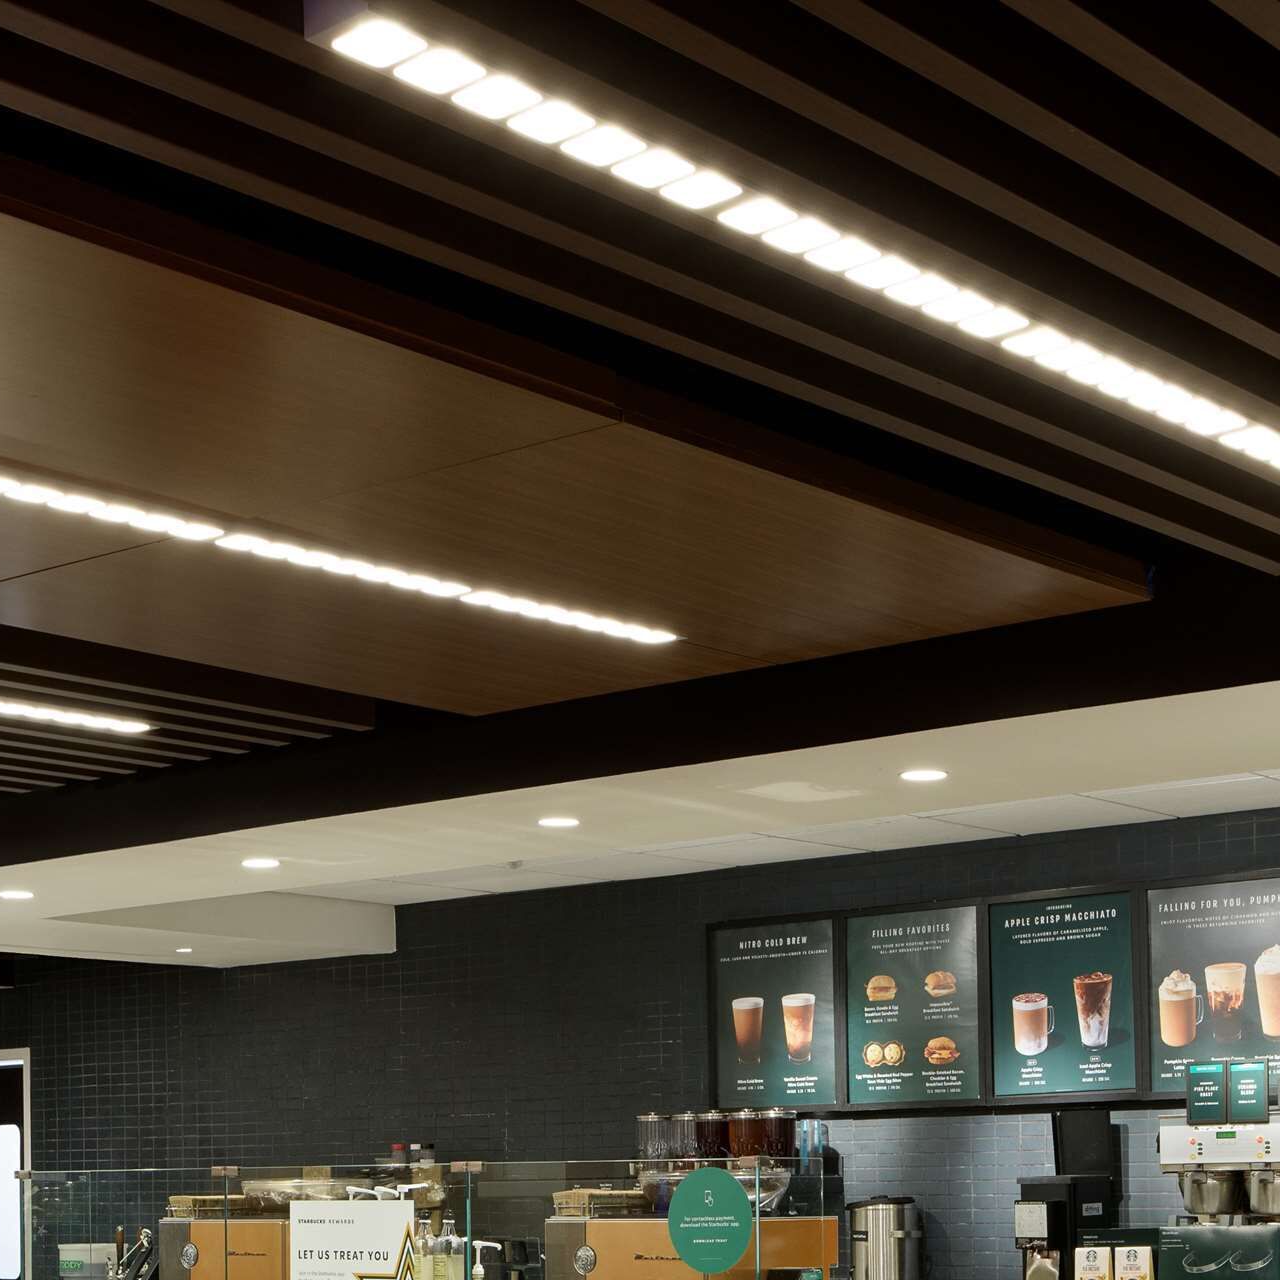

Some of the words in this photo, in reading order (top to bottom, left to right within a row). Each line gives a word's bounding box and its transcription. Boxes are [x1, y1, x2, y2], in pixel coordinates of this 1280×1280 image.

[1159, 901, 1196, 913] FALLING
[1201, 900, 1218, 909] FOR
[1004, 917, 1031, 928] APPLE
[1035, 914, 1061, 925] CRISP
[1065, 909, 1117, 922] MACCHIATO
[872, 928, 903, 938] FILLING
[906, 923, 950, 935] FAVORITES
[739, 940, 762, 950] NITRO
[765, 938, 783, 948] COLD
[786, 936, 808, 945] BREW
[298, 1250, 314, 1259] LET
[318, 1250, 330, 1260] US
[334, 1251, 364, 1260] TREAT
[368, 1251, 389, 1260] YOU
